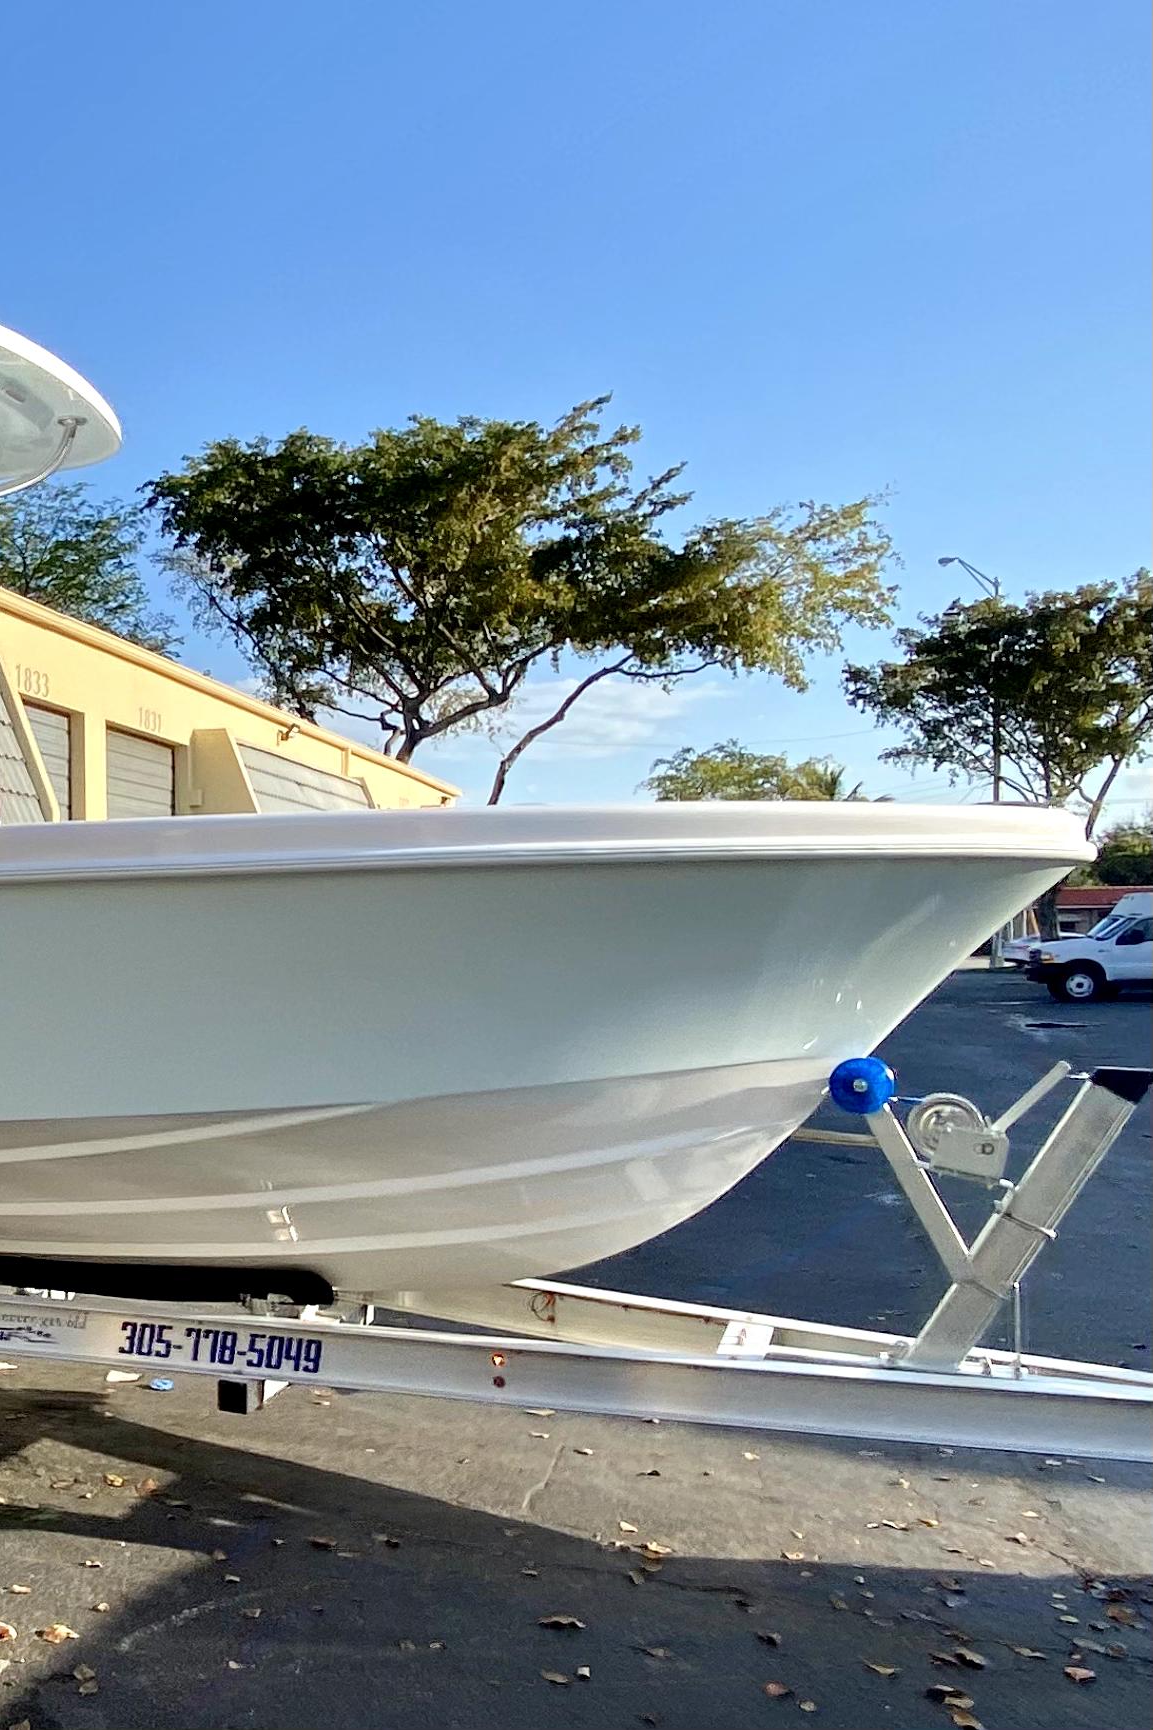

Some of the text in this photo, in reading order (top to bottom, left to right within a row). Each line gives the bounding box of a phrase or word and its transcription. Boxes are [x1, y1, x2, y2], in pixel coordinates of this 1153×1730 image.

[15, 663, 50, 698] 1833
[138, 707, 162, 733] 1831
[118, 1321, 323, 1374] 305-778-5049
